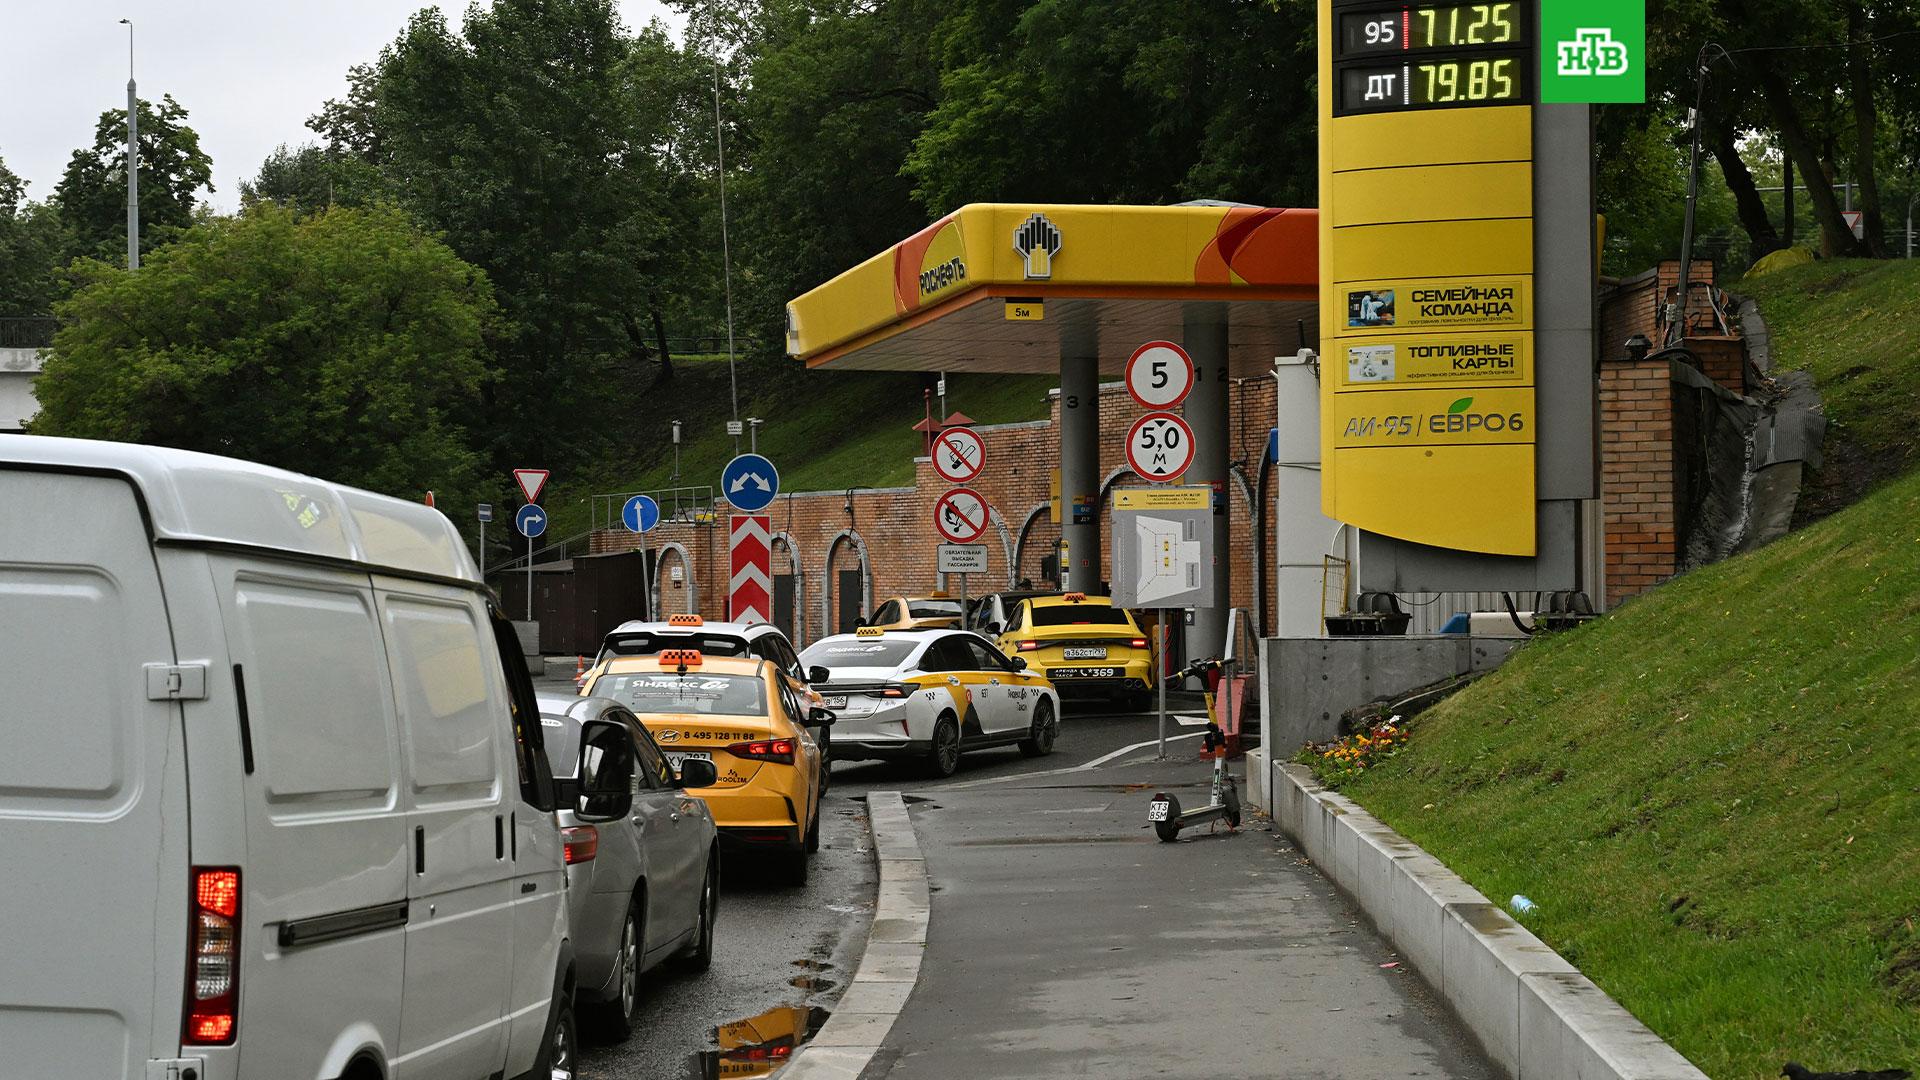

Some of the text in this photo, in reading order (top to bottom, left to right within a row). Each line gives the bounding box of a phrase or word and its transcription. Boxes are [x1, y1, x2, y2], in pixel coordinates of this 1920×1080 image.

[1365, 3, 1512, 46] 95 71.25
[1364, 59, 1512, 102] ДТ 79.85
[919, 256, 965, 296] РОСНЕФТЬ
[1411, 286, 1514, 302] СЕМЕЙНАЯ
[1421, 302, 1514, 317] КОМАНДА
[1408, 344, 1514, 358] ТОПЛИВНЫЕ
[1452, 357, 1514, 369] КАРТЫ
[1151, 361, 1168, 389] 5
[1067, 395, 1079, 409] 3
[1141, 426, 1180, 452] 5,0
[715, 732, 730, 740] 128
